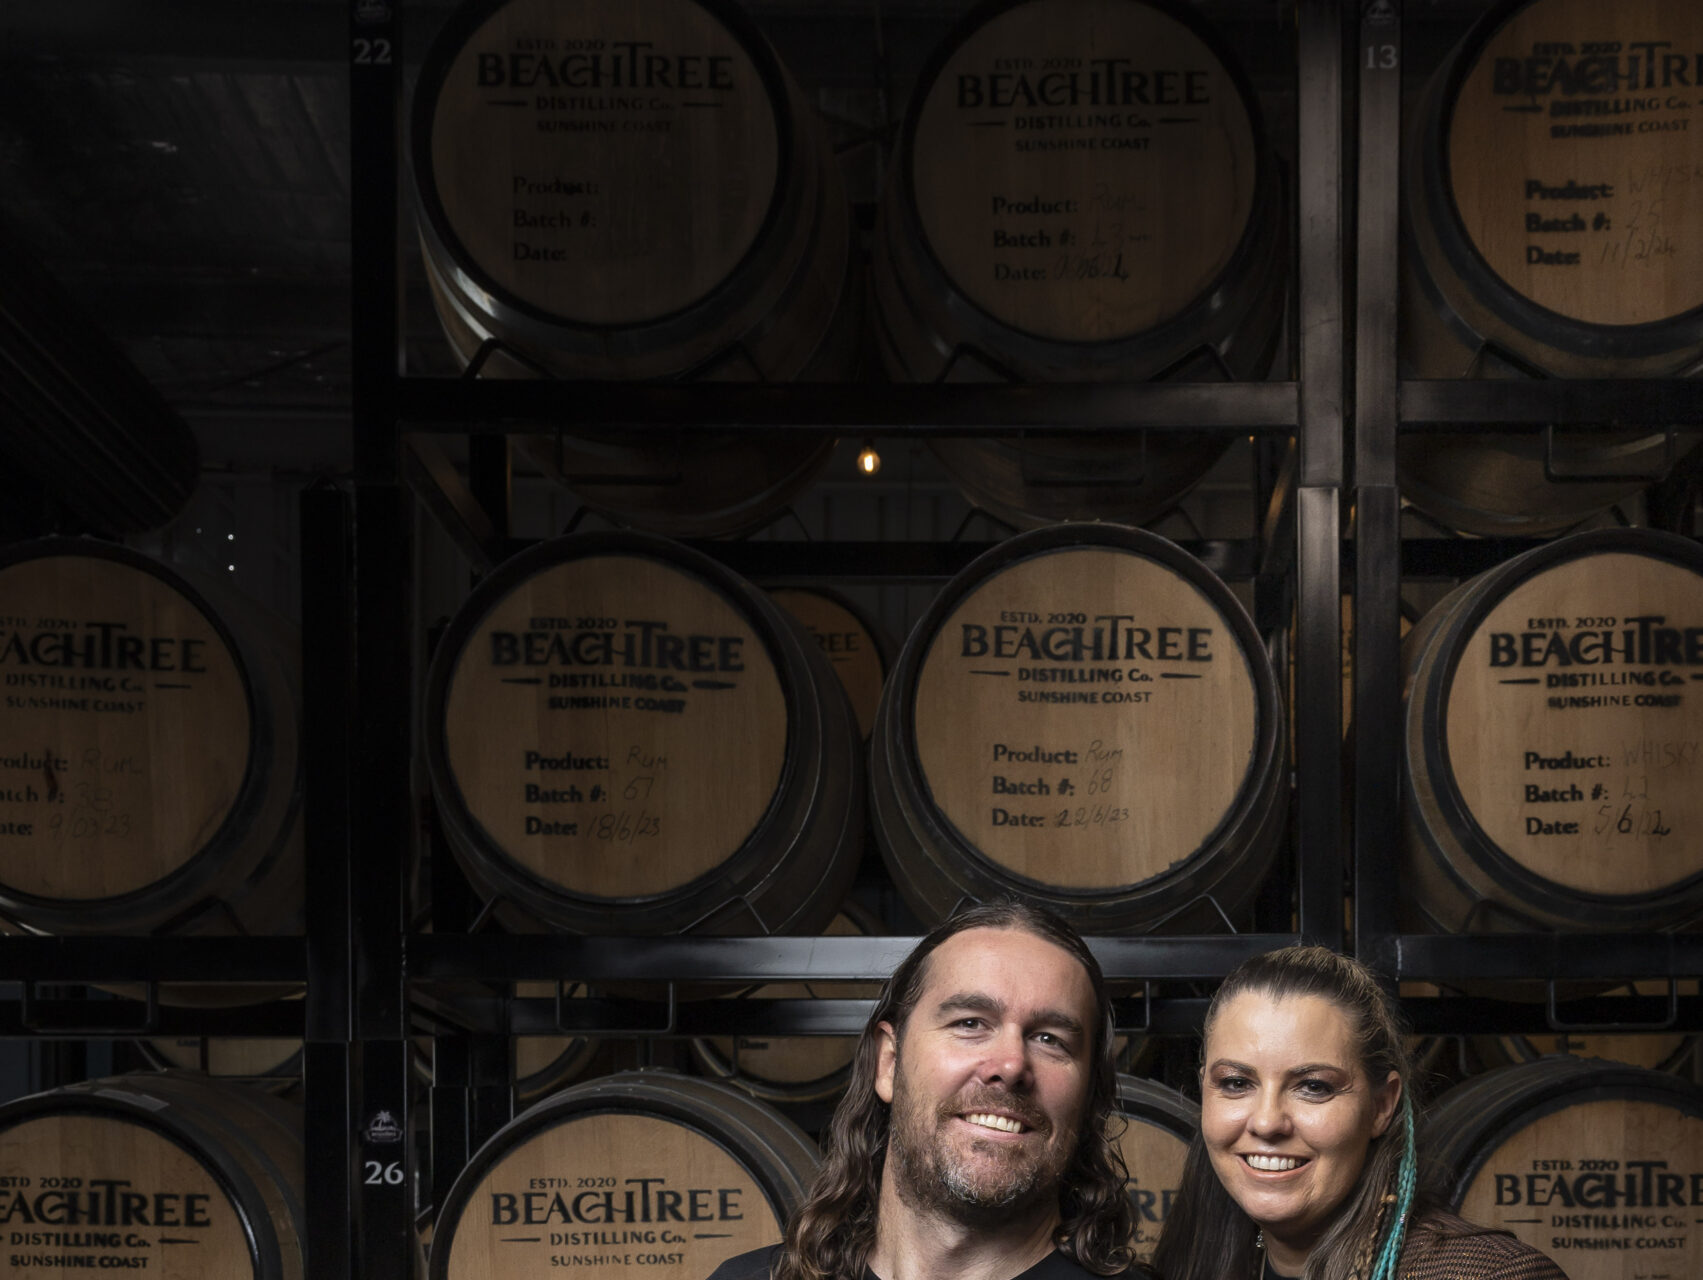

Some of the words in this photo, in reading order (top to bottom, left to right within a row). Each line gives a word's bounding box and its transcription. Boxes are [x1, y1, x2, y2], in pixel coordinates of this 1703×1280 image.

[353, 38, 392, 64] 22
[1365, 44, 1398, 69] 13
[477, 42, 734, 90] BEACHTREE
[1493, 41, 1703, 95] BEACHTR
[957, 59, 1211, 108] BEACHTREE
[536, 96, 643, 111] DISTILLING
[537, 120, 616, 132] SUNSHINE
[1015, 115, 1122, 130] DISTILLING
[1638, 119, 1690, 133] COAST
[1015, 137, 1096, 151] SUNSHINE
[1101, 137, 1151, 150] COAST
[1526, 180, 1614, 200] Product:
[992, 196, 1079, 214] Product:
[513, 208, 571, 228] Batch
[1526, 213, 1586, 232] Batch
[993, 229, 1050, 248] Batch
[514, 242, 567, 261] Date:
[1527, 246, 1580, 265] Date:
[994, 263, 1047, 281] Date:
[576, 618, 618, 629] 2020
[1001, 611, 1042, 624] ESTD.
[1048, 612, 1086, 624] 2020
[1528, 617, 1570, 629] ESTD.
[1576, 617, 1616, 628] 2020
[0, 622, 206, 673] ACHTREE
[491, 620, 745, 673] BEACHTREE
[961, 615, 1213, 662] BEACHTREE
[1489, 616, 1703, 667] BEACHTRE
[6, 673, 116, 692] DISTILLING
[548, 674, 659, 691] DISTILLING
[1018, 668, 1123, 682] DISTILLING
[1128, 669, 1153, 682] Co.
[1547, 672, 1656, 688] DISTILLING
[6, 695, 88, 711] SUNSHINE
[93, 699, 145, 714] COAST
[549, 697, 631, 710] SUNSHINE
[634, 698, 686, 714] COAST
[1018, 690, 1098, 703] SUNSHINE
[1102, 692, 1152, 703] COAST
[1547, 695, 1630, 709] SUNSHINE
[1634, 694, 1684, 707] COAST
[0, 751, 68, 772] roduct:
[525, 751, 610, 770] Product:
[993, 744, 1078, 764] Product:
[1525, 751, 1610, 770] Product:
[0, 785, 39, 802] atch
[525, 784, 583, 803] Batch
[992, 776, 1050, 795] Batch
[1525, 784, 1584, 803] Batch
[1591, 784, 1609, 801] #:
[525, 816, 578, 836] Date:
[992, 808, 1045, 827] Date:
[1526, 817, 1579, 836] Date:
[0, 822, 33, 836] ate:
[364, 1161, 404, 1185] 26
[1579, 1160, 1619, 1171] 2020
[39, 1177, 82, 1189] 2020
[530, 1177, 572, 1189] ESTD.
[576, 1177, 617, 1188] 2020
[0, 1180, 210, 1227] ACHTREE
[491, 1178, 744, 1225] BEACHTREE
[1551, 1214, 1656, 1229] DISTILLING
[1662, 1215, 1687, 1228] Co.
[10, 1232, 121, 1248] DISTILLING
[125, 1234, 151, 1248] Co.
[550, 1231, 656, 1246] DISTILLING
[661, 1230, 686, 1244] Co.
[1551, 1237, 1631, 1250] SUNSHINE
[1636, 1237, 1686, 1249] COAST
[10, 1255, 96, 1268] SUNSHINE
[98, 1256, 148, 1268] COAST
[551, 1254, 632, 1267] SUNSHINE
[636, 1253, 684, 1265] COAST
